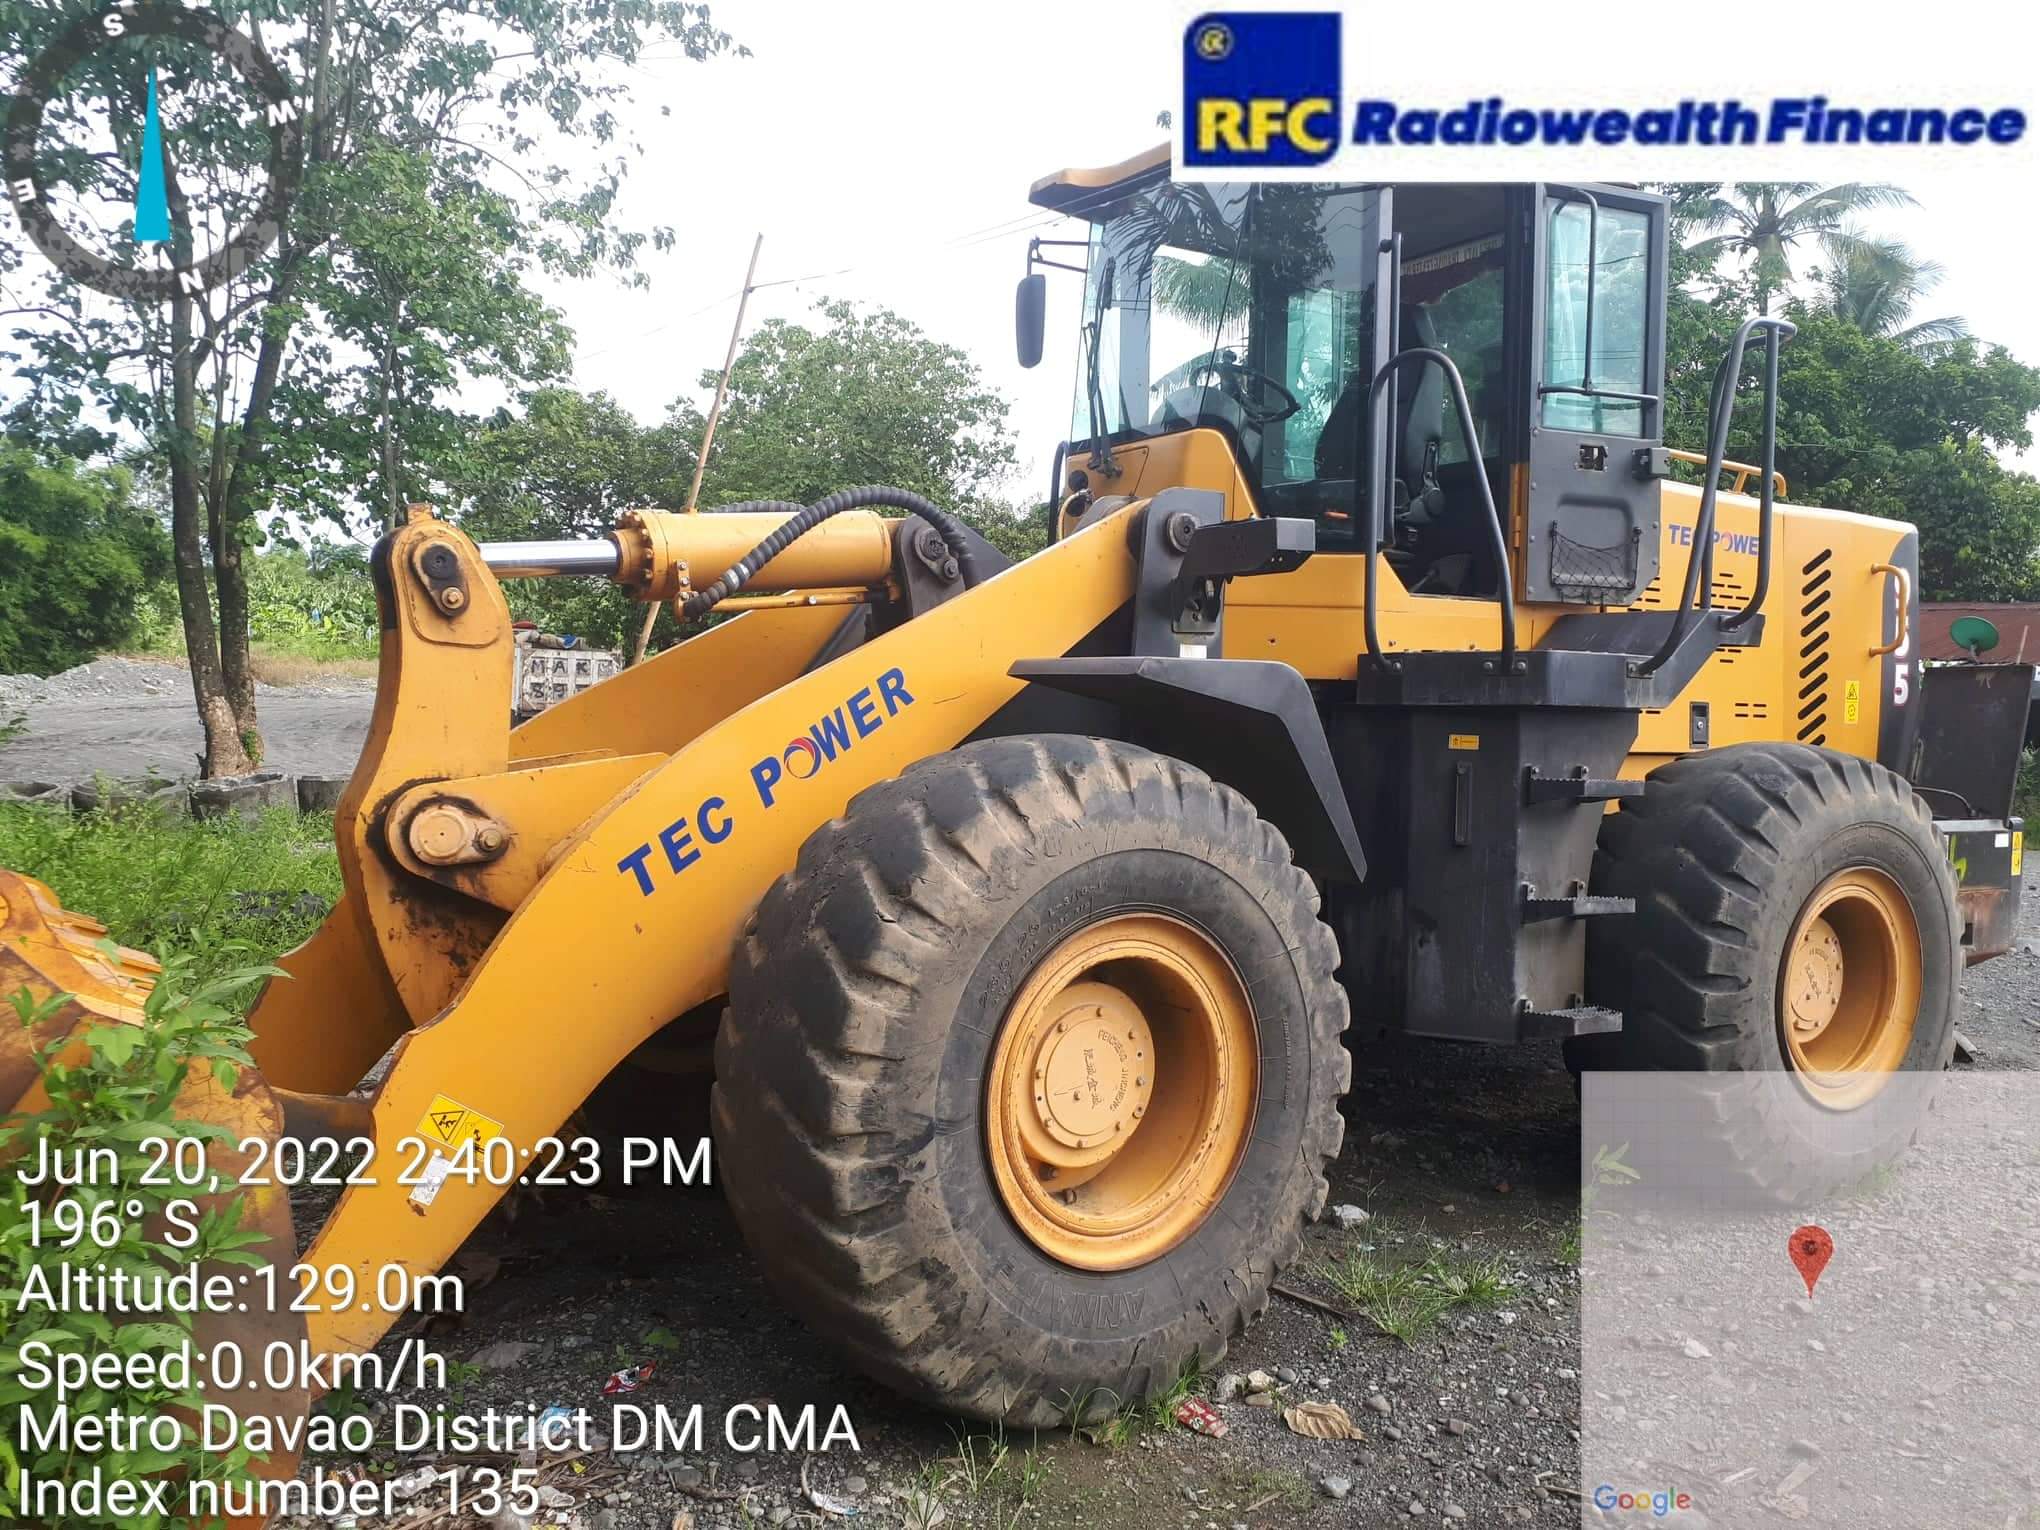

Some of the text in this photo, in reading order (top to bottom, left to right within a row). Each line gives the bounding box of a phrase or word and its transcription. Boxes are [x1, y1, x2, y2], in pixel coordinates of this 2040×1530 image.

[1668, 523, 1761, 556] TE POWE
[617, 667, 915, 898] TEC POWER
